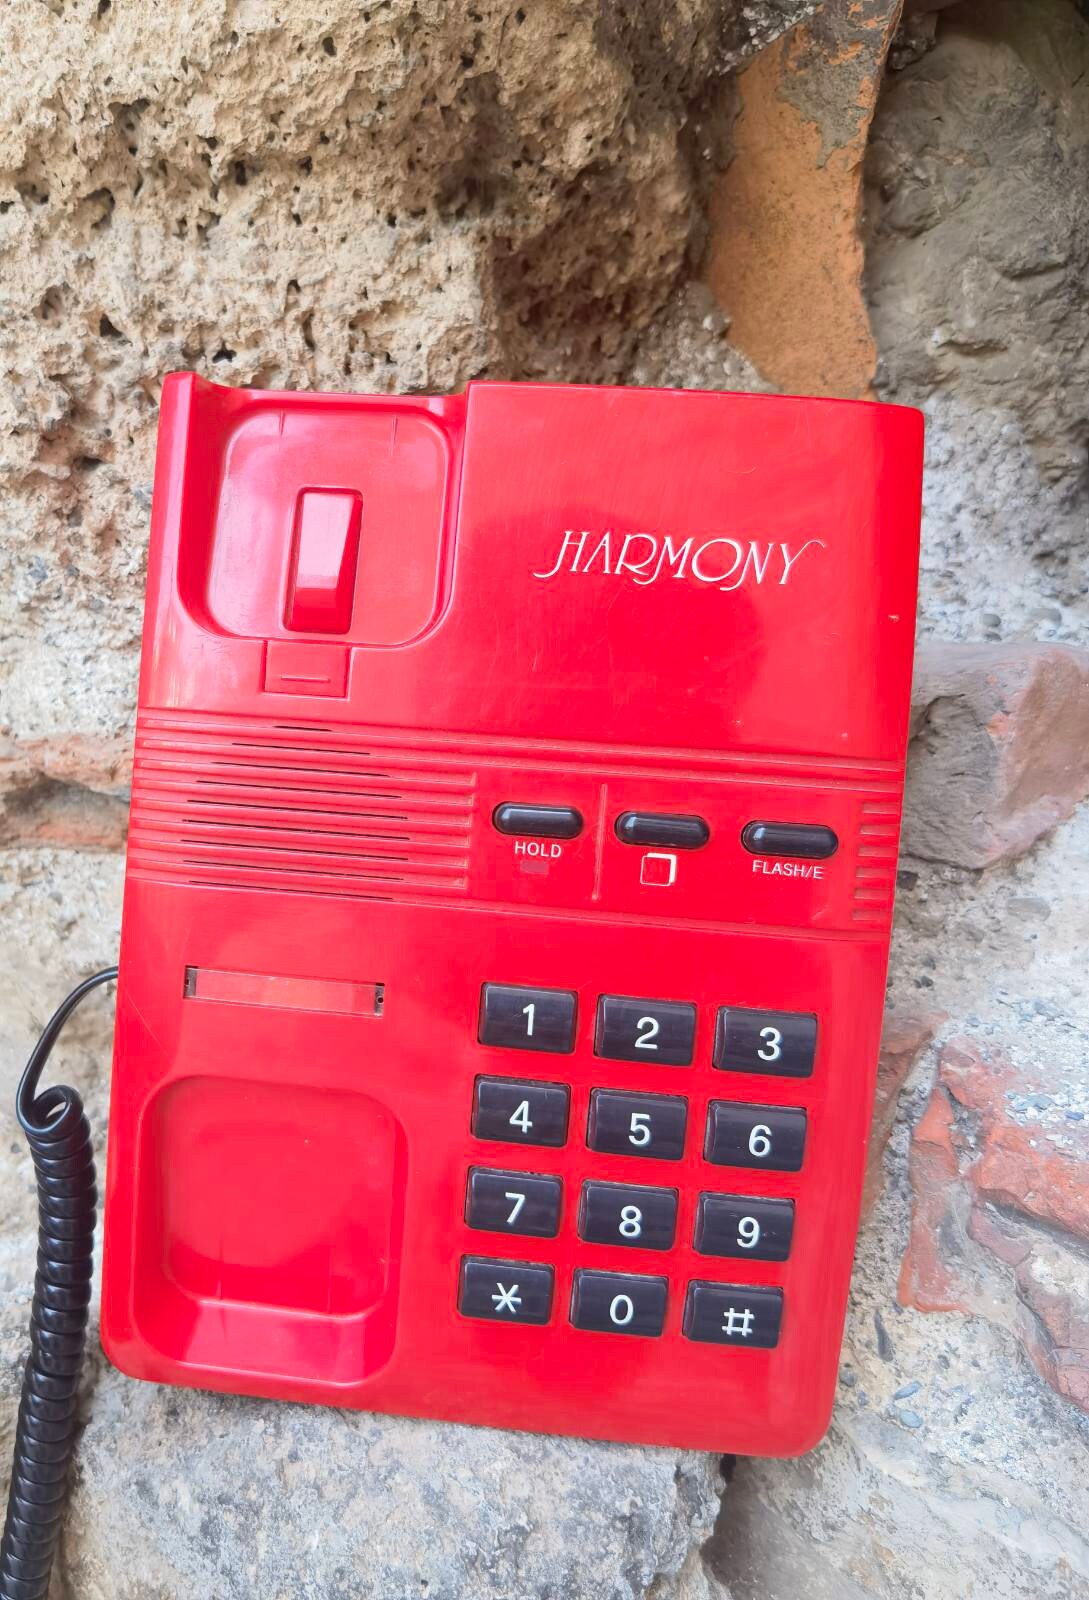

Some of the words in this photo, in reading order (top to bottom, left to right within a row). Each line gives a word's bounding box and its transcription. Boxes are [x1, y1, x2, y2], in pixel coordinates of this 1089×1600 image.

[533, 531, 826, 590] HARMONY
[515, 841, 561, 858] HOLD
[752, 860, 824, 879] FLASH/E
[522, 1004, 534, 1036] 1
[635, 1017, 659, 1049] 2
[758, 1028, 780, 1060] 3
[509, 1101, 532, 1132] 4
[629, 1114, 650, 1145] 5
[749, 1125, 772, 1156] 6
[505, 1193, 525, 1224] 7
[619, 1206, 641, 1237] 8
[737, 1217, 760, 1248] 9
[610, 1295, 633, 1325] 0
[722, 1308, 754, 1336] #
